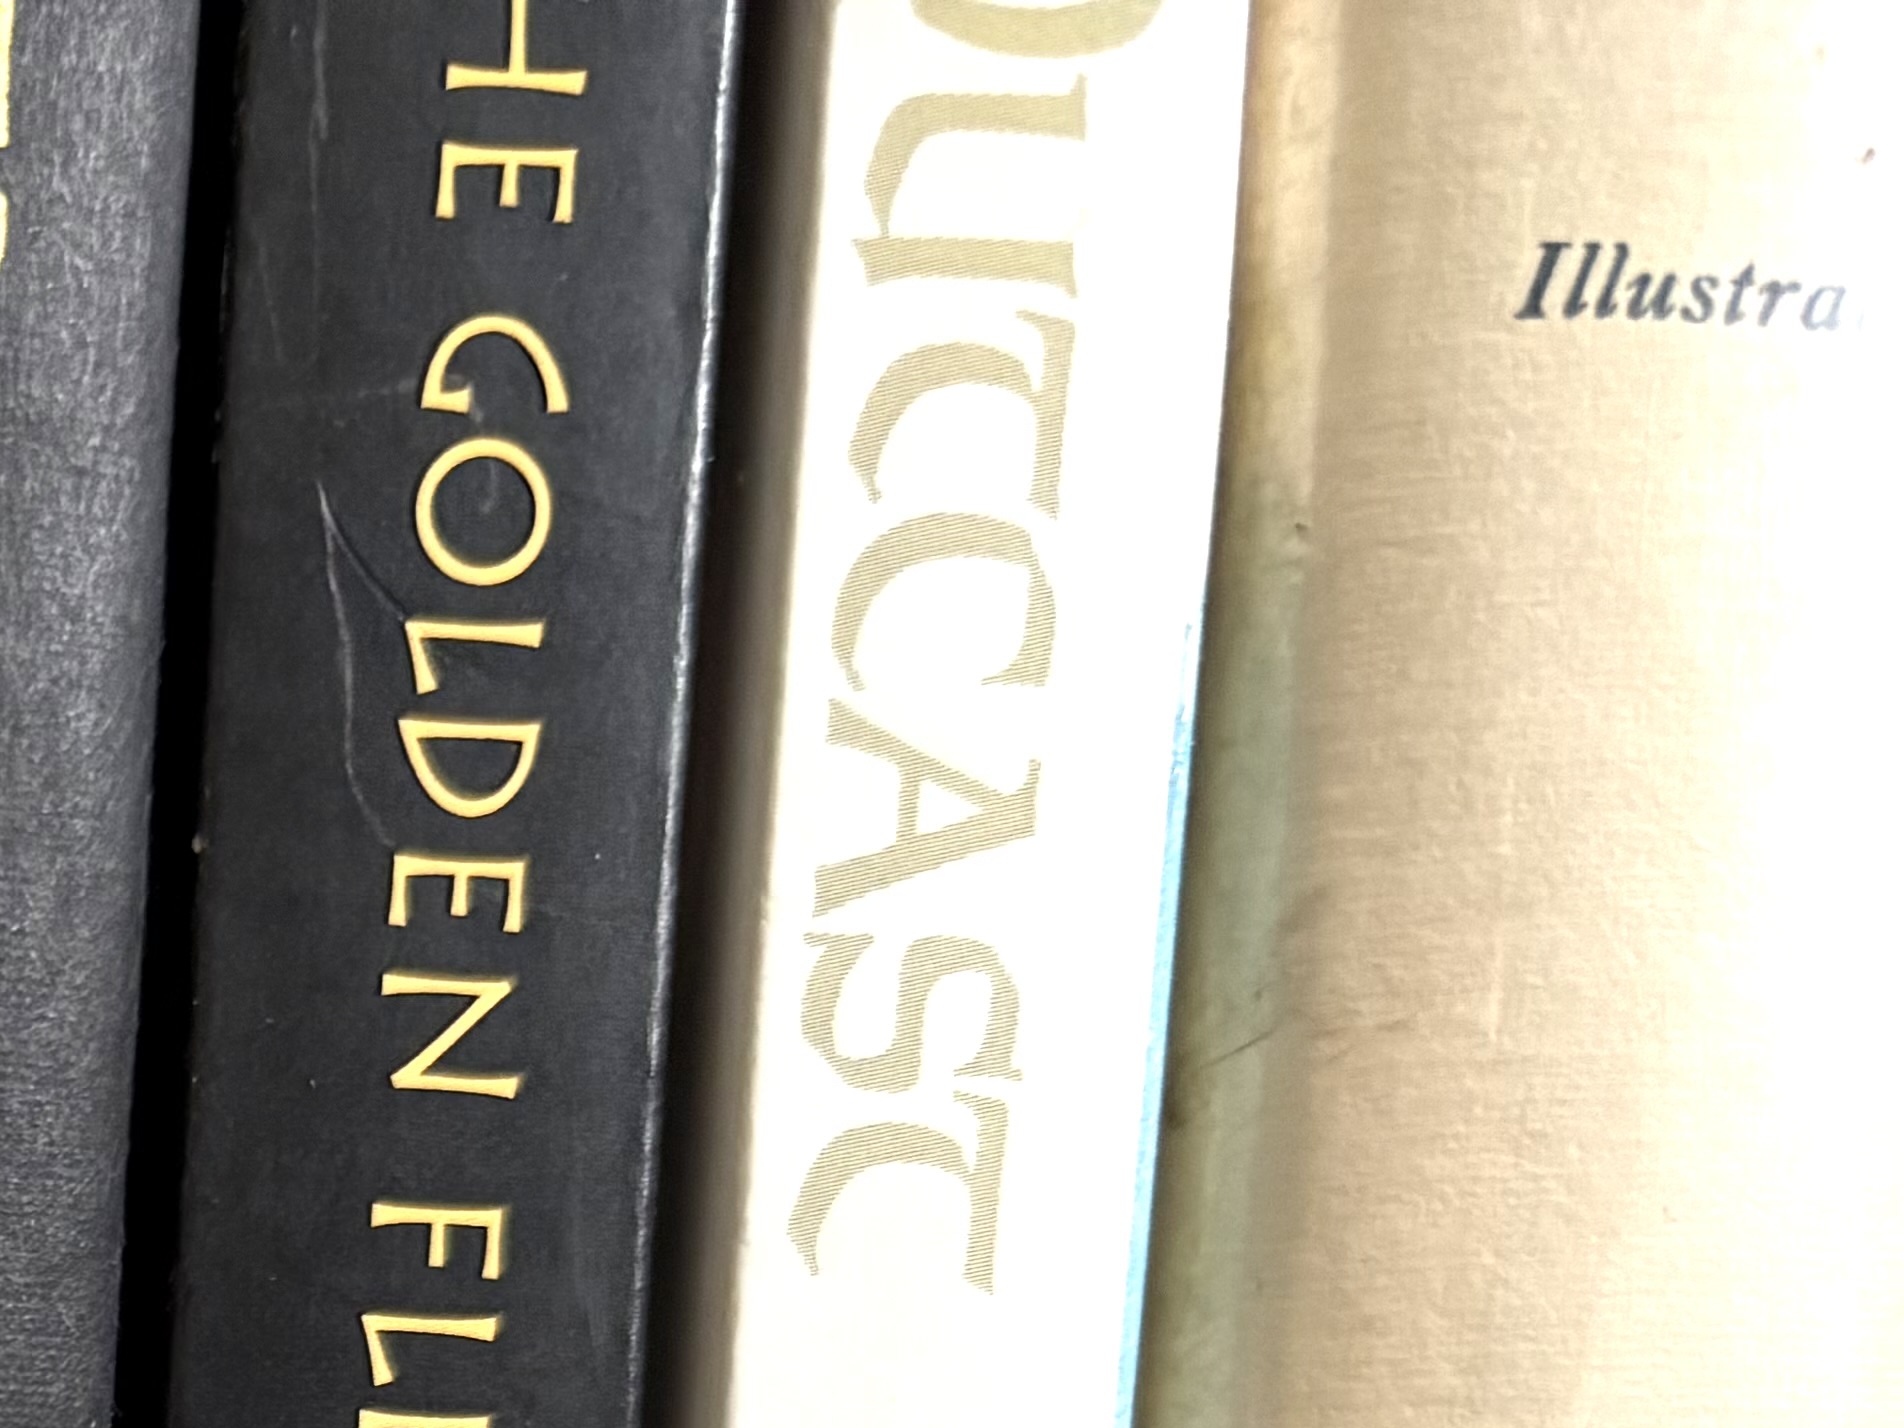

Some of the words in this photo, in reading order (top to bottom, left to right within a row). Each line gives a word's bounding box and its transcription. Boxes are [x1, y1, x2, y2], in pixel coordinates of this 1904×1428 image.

[787, 0, 1164, 1295] UTCAST
[1513, 240, 1866, 331] Illustra
[379, 314, 571, 1101] GOLDEN
